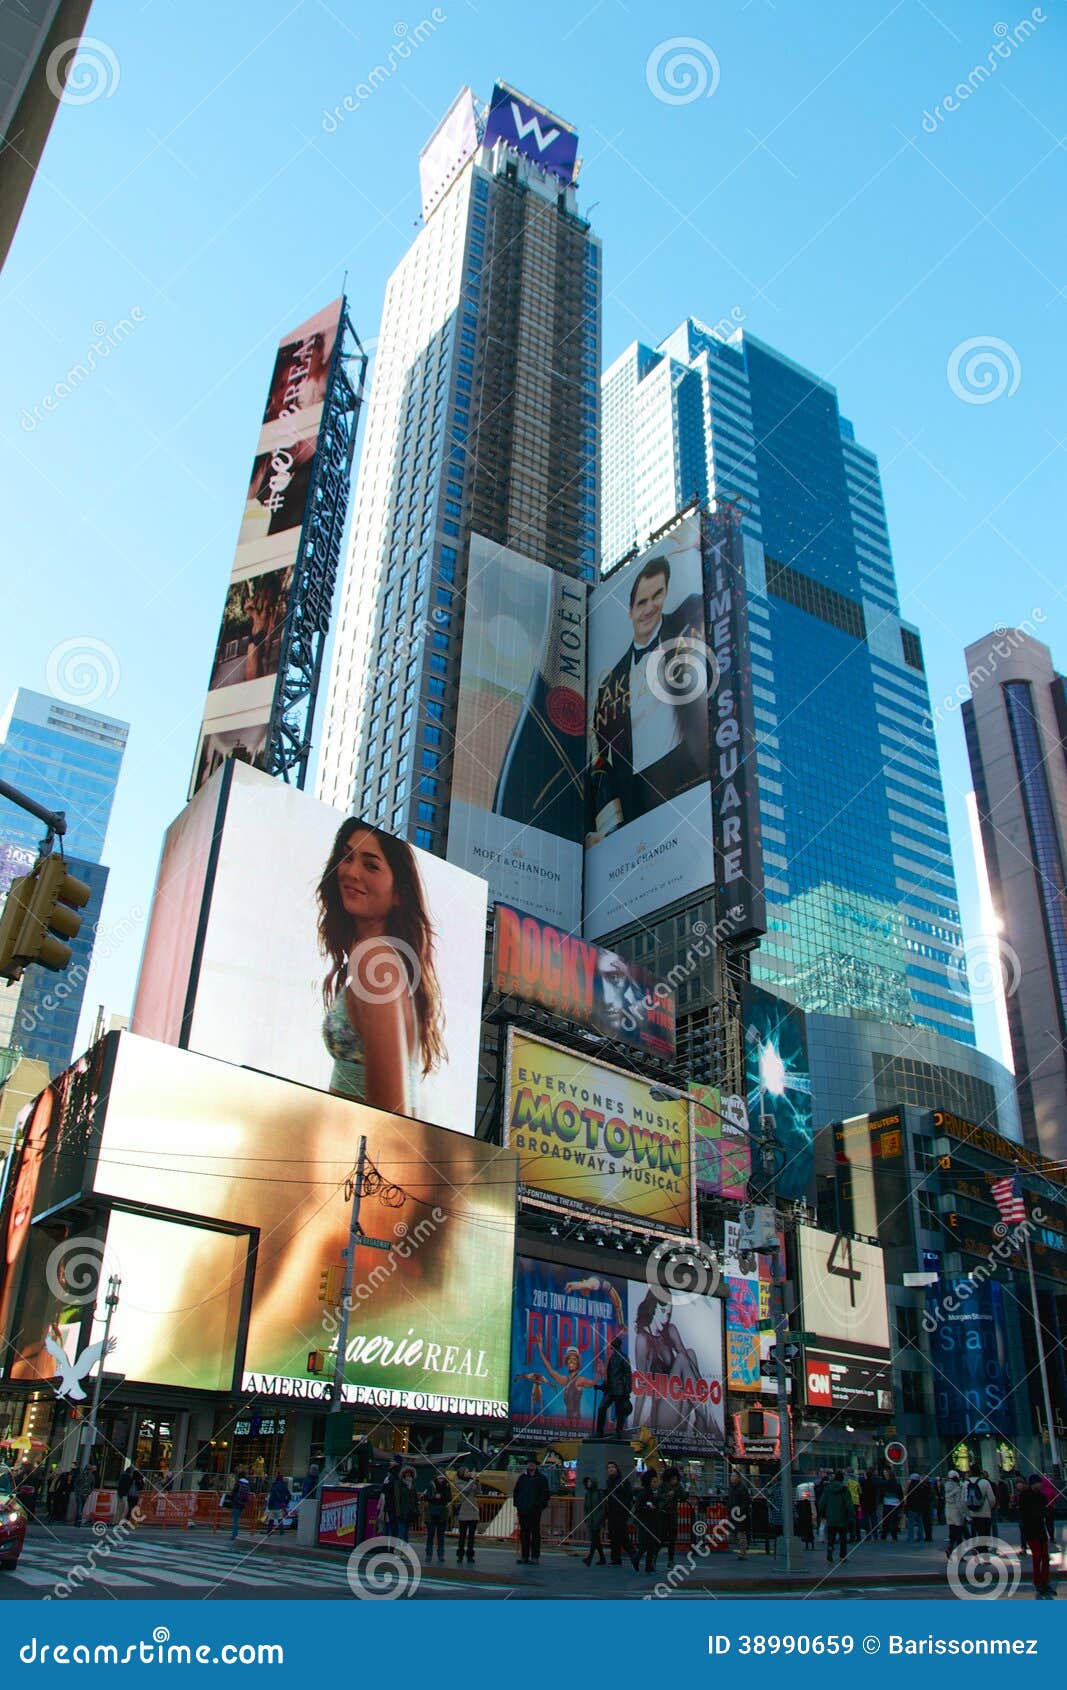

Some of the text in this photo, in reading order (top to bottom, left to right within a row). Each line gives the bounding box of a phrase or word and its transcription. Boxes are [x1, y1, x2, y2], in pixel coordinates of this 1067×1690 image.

[511, 101, 560, 153] W
[707, 538, 732, 674] TIMES
[715, 689, 743, 884] SQUARE
[511, 859, 561, 881] CHANDON
[497, 905, 597, 1007] ROCKY
[495, 973, 592, 1020] BROADWAY
[518, 1067, 625, 1114] EVERYONE'S
[633, 1107, 681, 1134] MUSIC
[511, 1087, 683, 1177] MOTOWN
[516, 1135, 682, 1194] BROADWAY'S MUSICAL
[532, 1289, 548, 1308] 2013
[549, 1292, 566, 1312] TONY
[566, 1296, 586, 1315] AWARD
[357, 1386, 409, 1409] EAGLE
[414, 1393, 509, 1418] OUTFITTERS
[631, 1370, 723, 1406] CHICAGO
[808, 1372, 830, 1395] CNN
